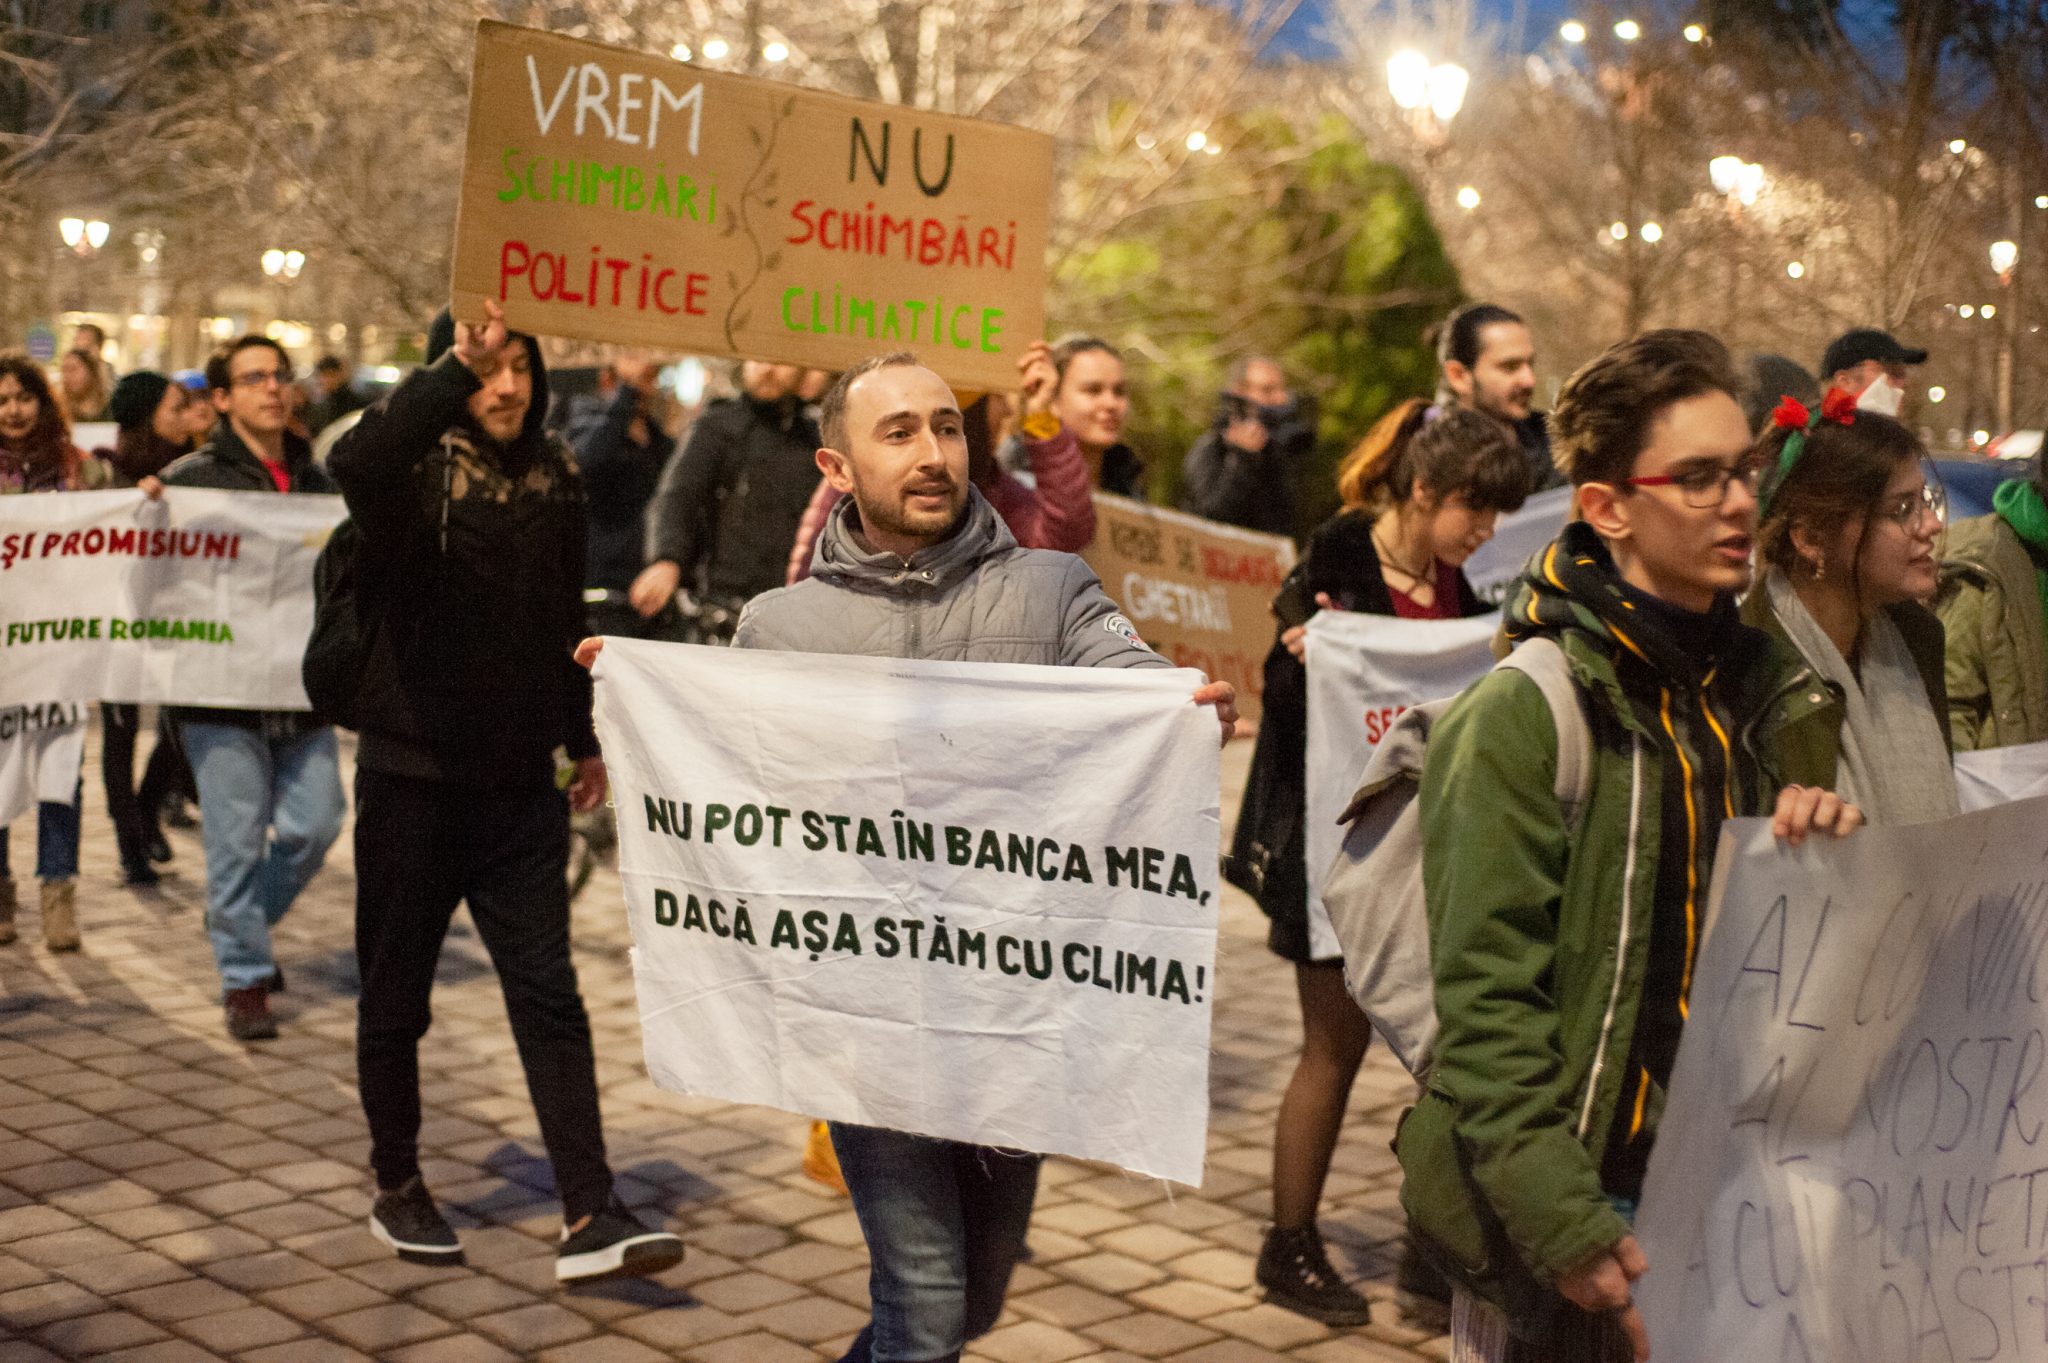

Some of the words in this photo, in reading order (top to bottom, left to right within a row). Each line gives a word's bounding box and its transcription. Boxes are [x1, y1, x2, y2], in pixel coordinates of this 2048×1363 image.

[526, 54, 704, 156] VREM
[849, 117, 955, 198] NU
[500, 240, 710, 316] POLITICE
[782, 282, 1006, 353] CLIMATICE
[41, 528, 241, 561] PROMISIUNI
[7, 617, 103, 646] FUTURE
[109, 617, 235, 645] ROMANIA
[643, 795, 693, 840] NU
[703, 803, 791, 848] POT
[801, 810, 887, 857] STA
[889, 809, 935, 863] ÎN
[945, 825, 1094, 884] BANCA
[1105, 845, 1212, 906] MEA,
[653, 888, 757, 946] DACĂ
[770, 910, 862, 962] AȘA
[874, 914, 986, 970] STĂM
[995, 935, 1053, 980] CU
[1062, 941, 1205, 1005] CLIMA!
[1720, 894, 1830, 1032] AL
[1848, 1166, 2048, 1272] PLANET
